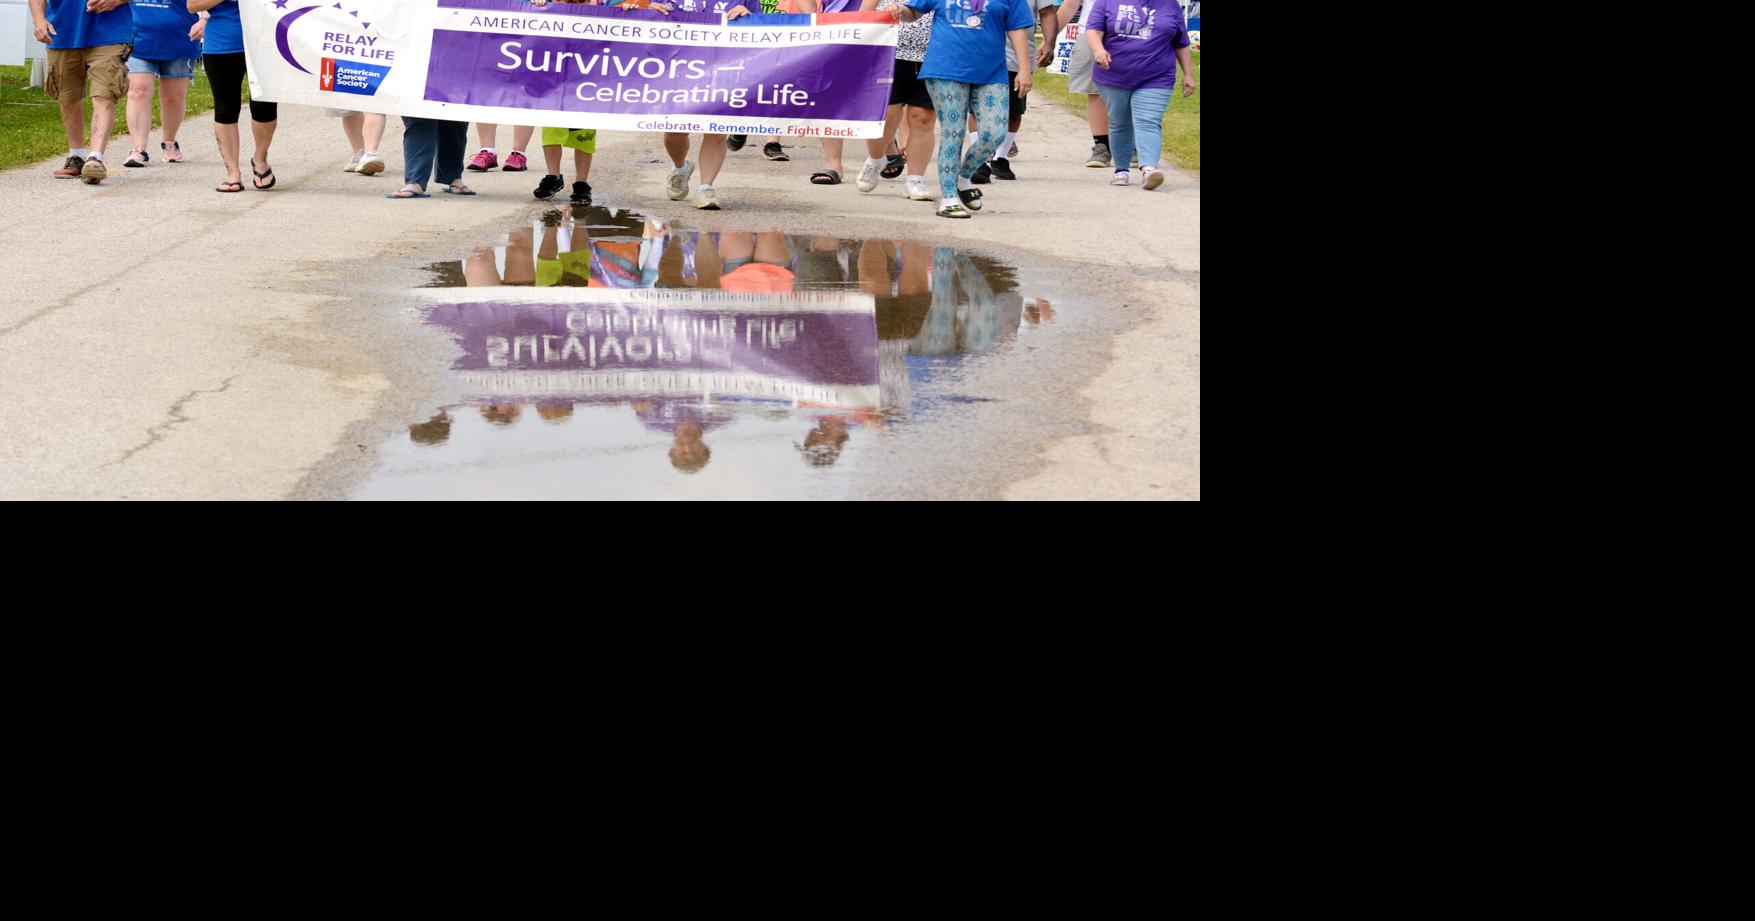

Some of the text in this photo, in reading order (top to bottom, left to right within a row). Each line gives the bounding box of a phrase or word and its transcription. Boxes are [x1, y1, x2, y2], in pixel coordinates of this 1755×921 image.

[470, 16, 862, 43] AMERICAN CANCER SOCIETY RELAY FOR LIFE
[324, 32, 377, 46] RELAY
[323, 42, 394, 60] FOR LIFE
[497, 41, 705, 79] Survivors
[337, 67, 380, 77] American
[337, 73, 367, 81] Cancer
[337, 79, 368, 89] Society
[575, 81, 816, 108] Celebrating Life.
[637, 120, 858, 138] Celebrate. Remember. Fight Back.
